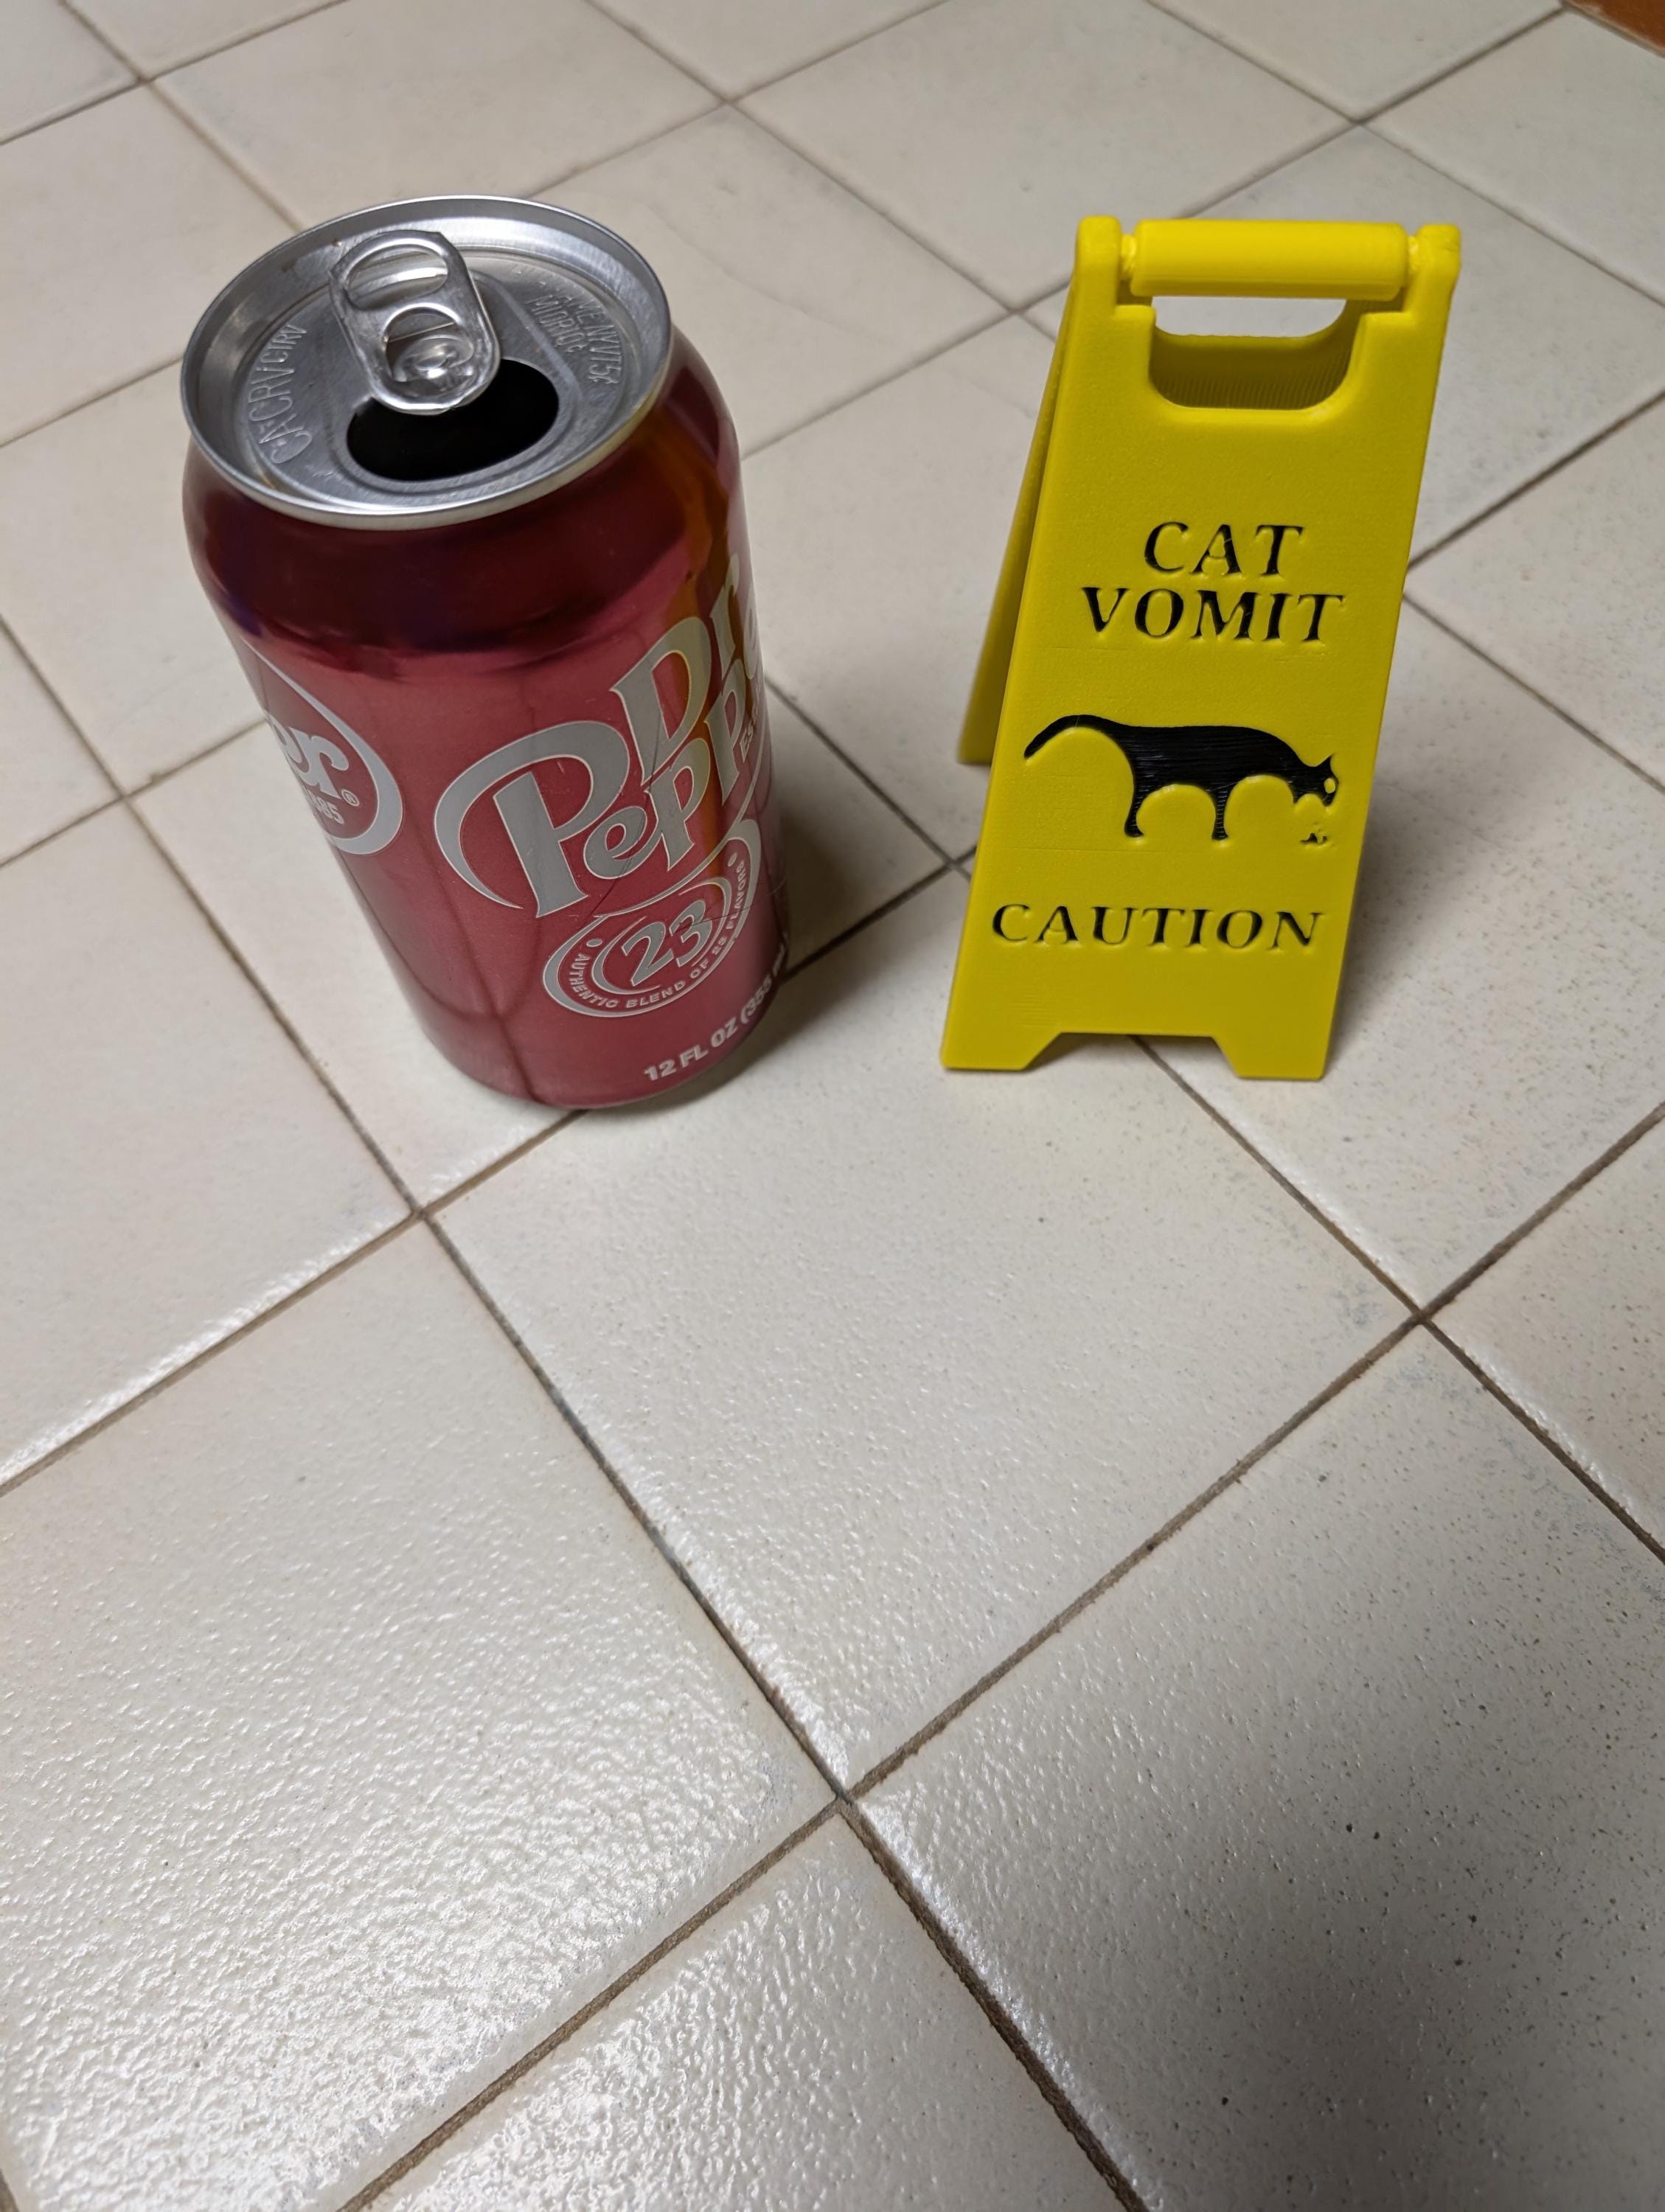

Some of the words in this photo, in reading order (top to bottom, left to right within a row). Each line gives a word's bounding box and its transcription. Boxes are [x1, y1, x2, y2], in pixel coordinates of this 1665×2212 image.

[248, 367, 294, 421] CRV
[259, 414, 312, 464] CA
[1144, 521, 1304, 577] CAT
[1081, 586, 1345, 642] VOMIT
[611, 554, 740, 786] Dr
[434, 579, 765, 917] Peppe
[569, 953, 619, 1008] AUTHENTIC
[625, 980, 686, 1008] BLEND
[690, 959, 710, 979] OF
[712, 936, 728, 956] 23
[726, 860, 748, 931] FLAVORS
[621, 900, 713, 987] 23
[992, 903, 1324, 950] CAUTION
[644, 1059, 677, 1082] 12
[679, 1044, 709, 1068] FL
[711, 1017, 739, 1048] OZ
